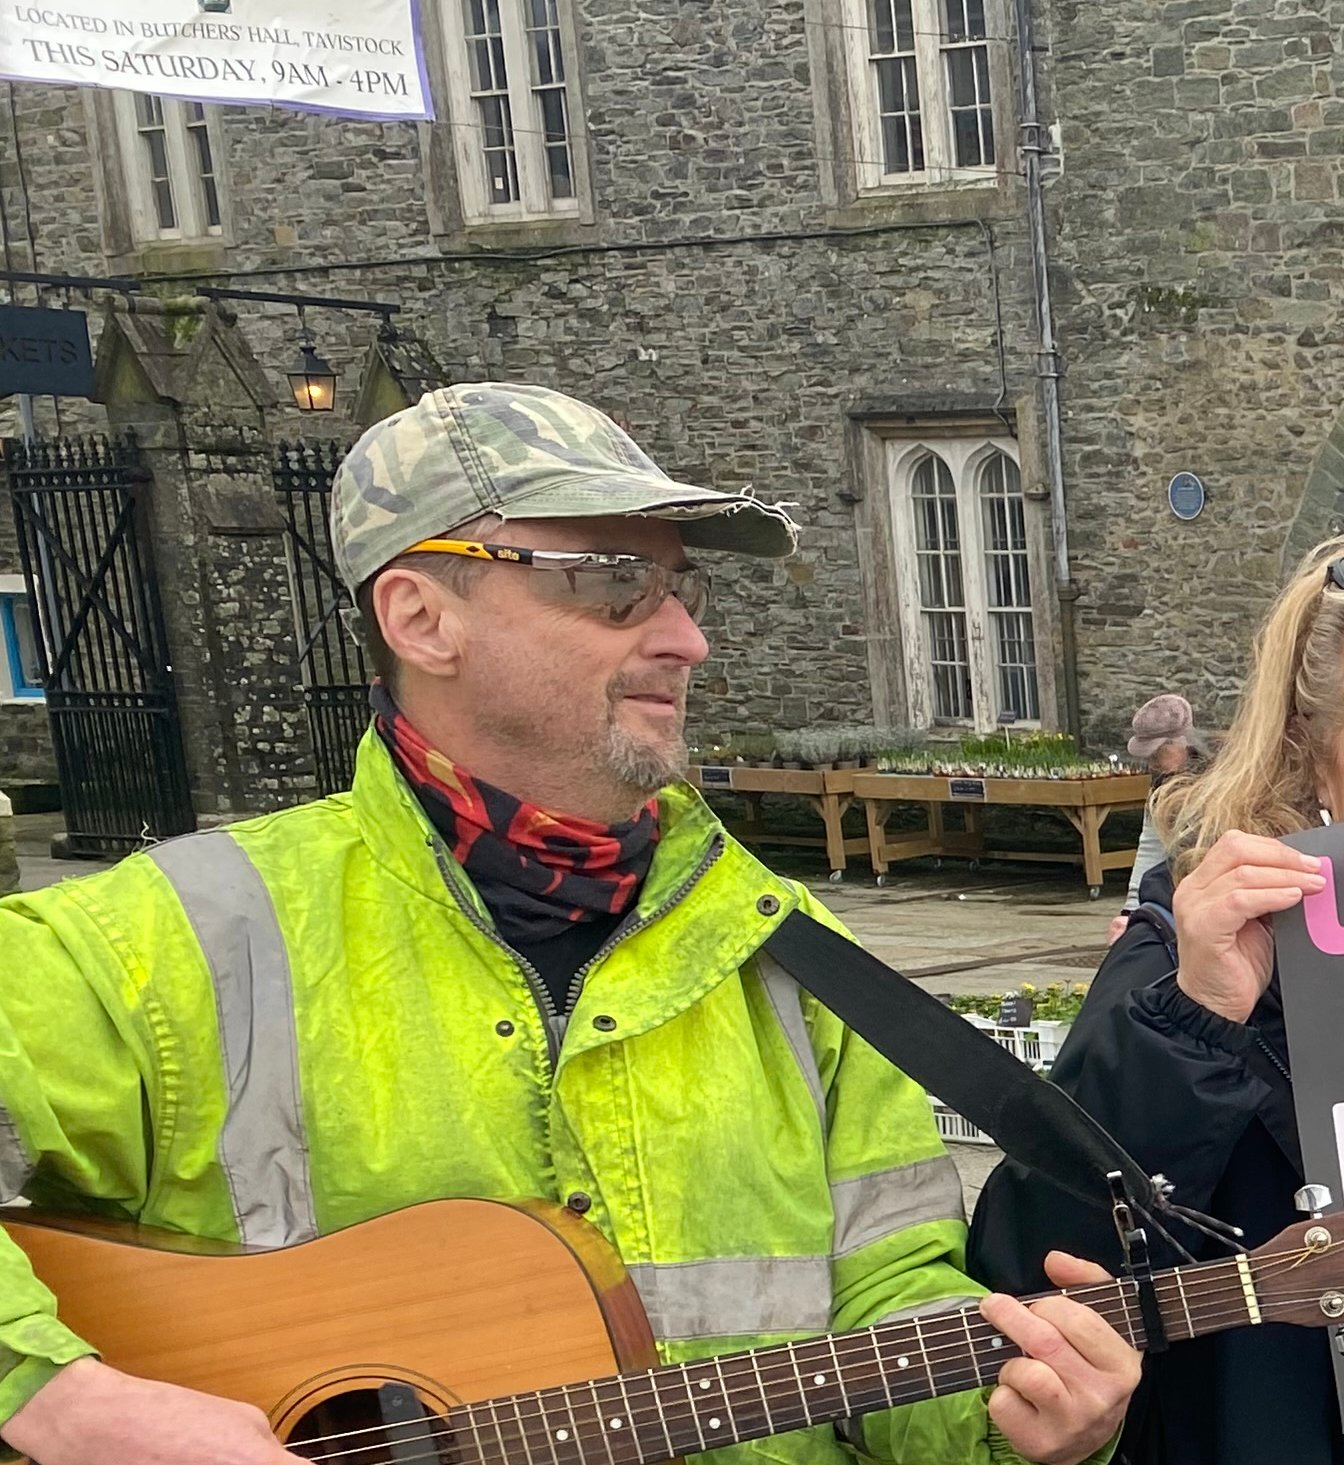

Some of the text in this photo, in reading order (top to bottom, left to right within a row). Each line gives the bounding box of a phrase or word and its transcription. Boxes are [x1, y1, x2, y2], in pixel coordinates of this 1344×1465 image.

[15, 5, 404, 56] LOCATED IN BUTCHERS' HALL, TAVISTOCK
[22, 38, 96, 67] THIS
[272, 60, 329, 88] 9AM
[349, 71, 409, 97] 4PM
